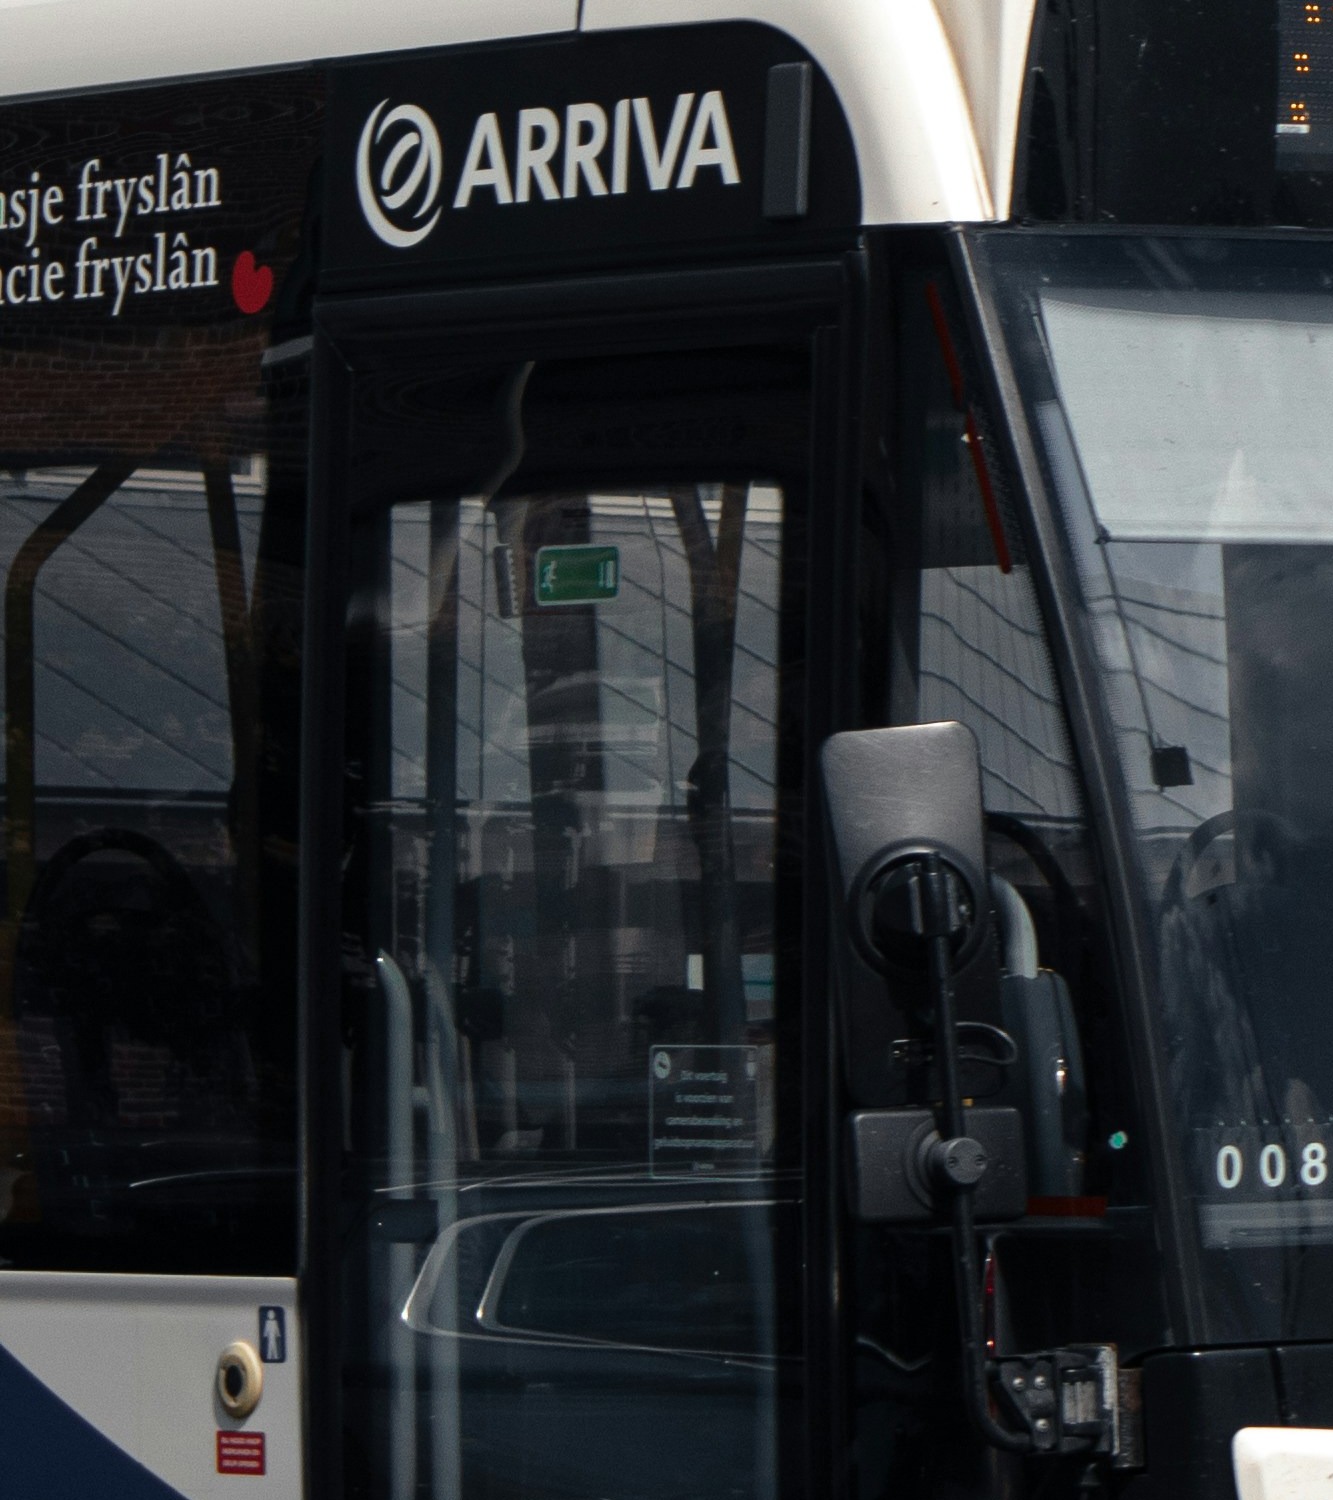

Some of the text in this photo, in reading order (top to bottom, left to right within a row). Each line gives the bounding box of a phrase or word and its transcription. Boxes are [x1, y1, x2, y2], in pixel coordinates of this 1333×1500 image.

[453, 90, 741, 209] ARRIVA
[0, 152, 221, 248] sje fryslân
[0, 231, 219, 317] cie fryslân
[1216, 1142, 1328, 1190] 008
